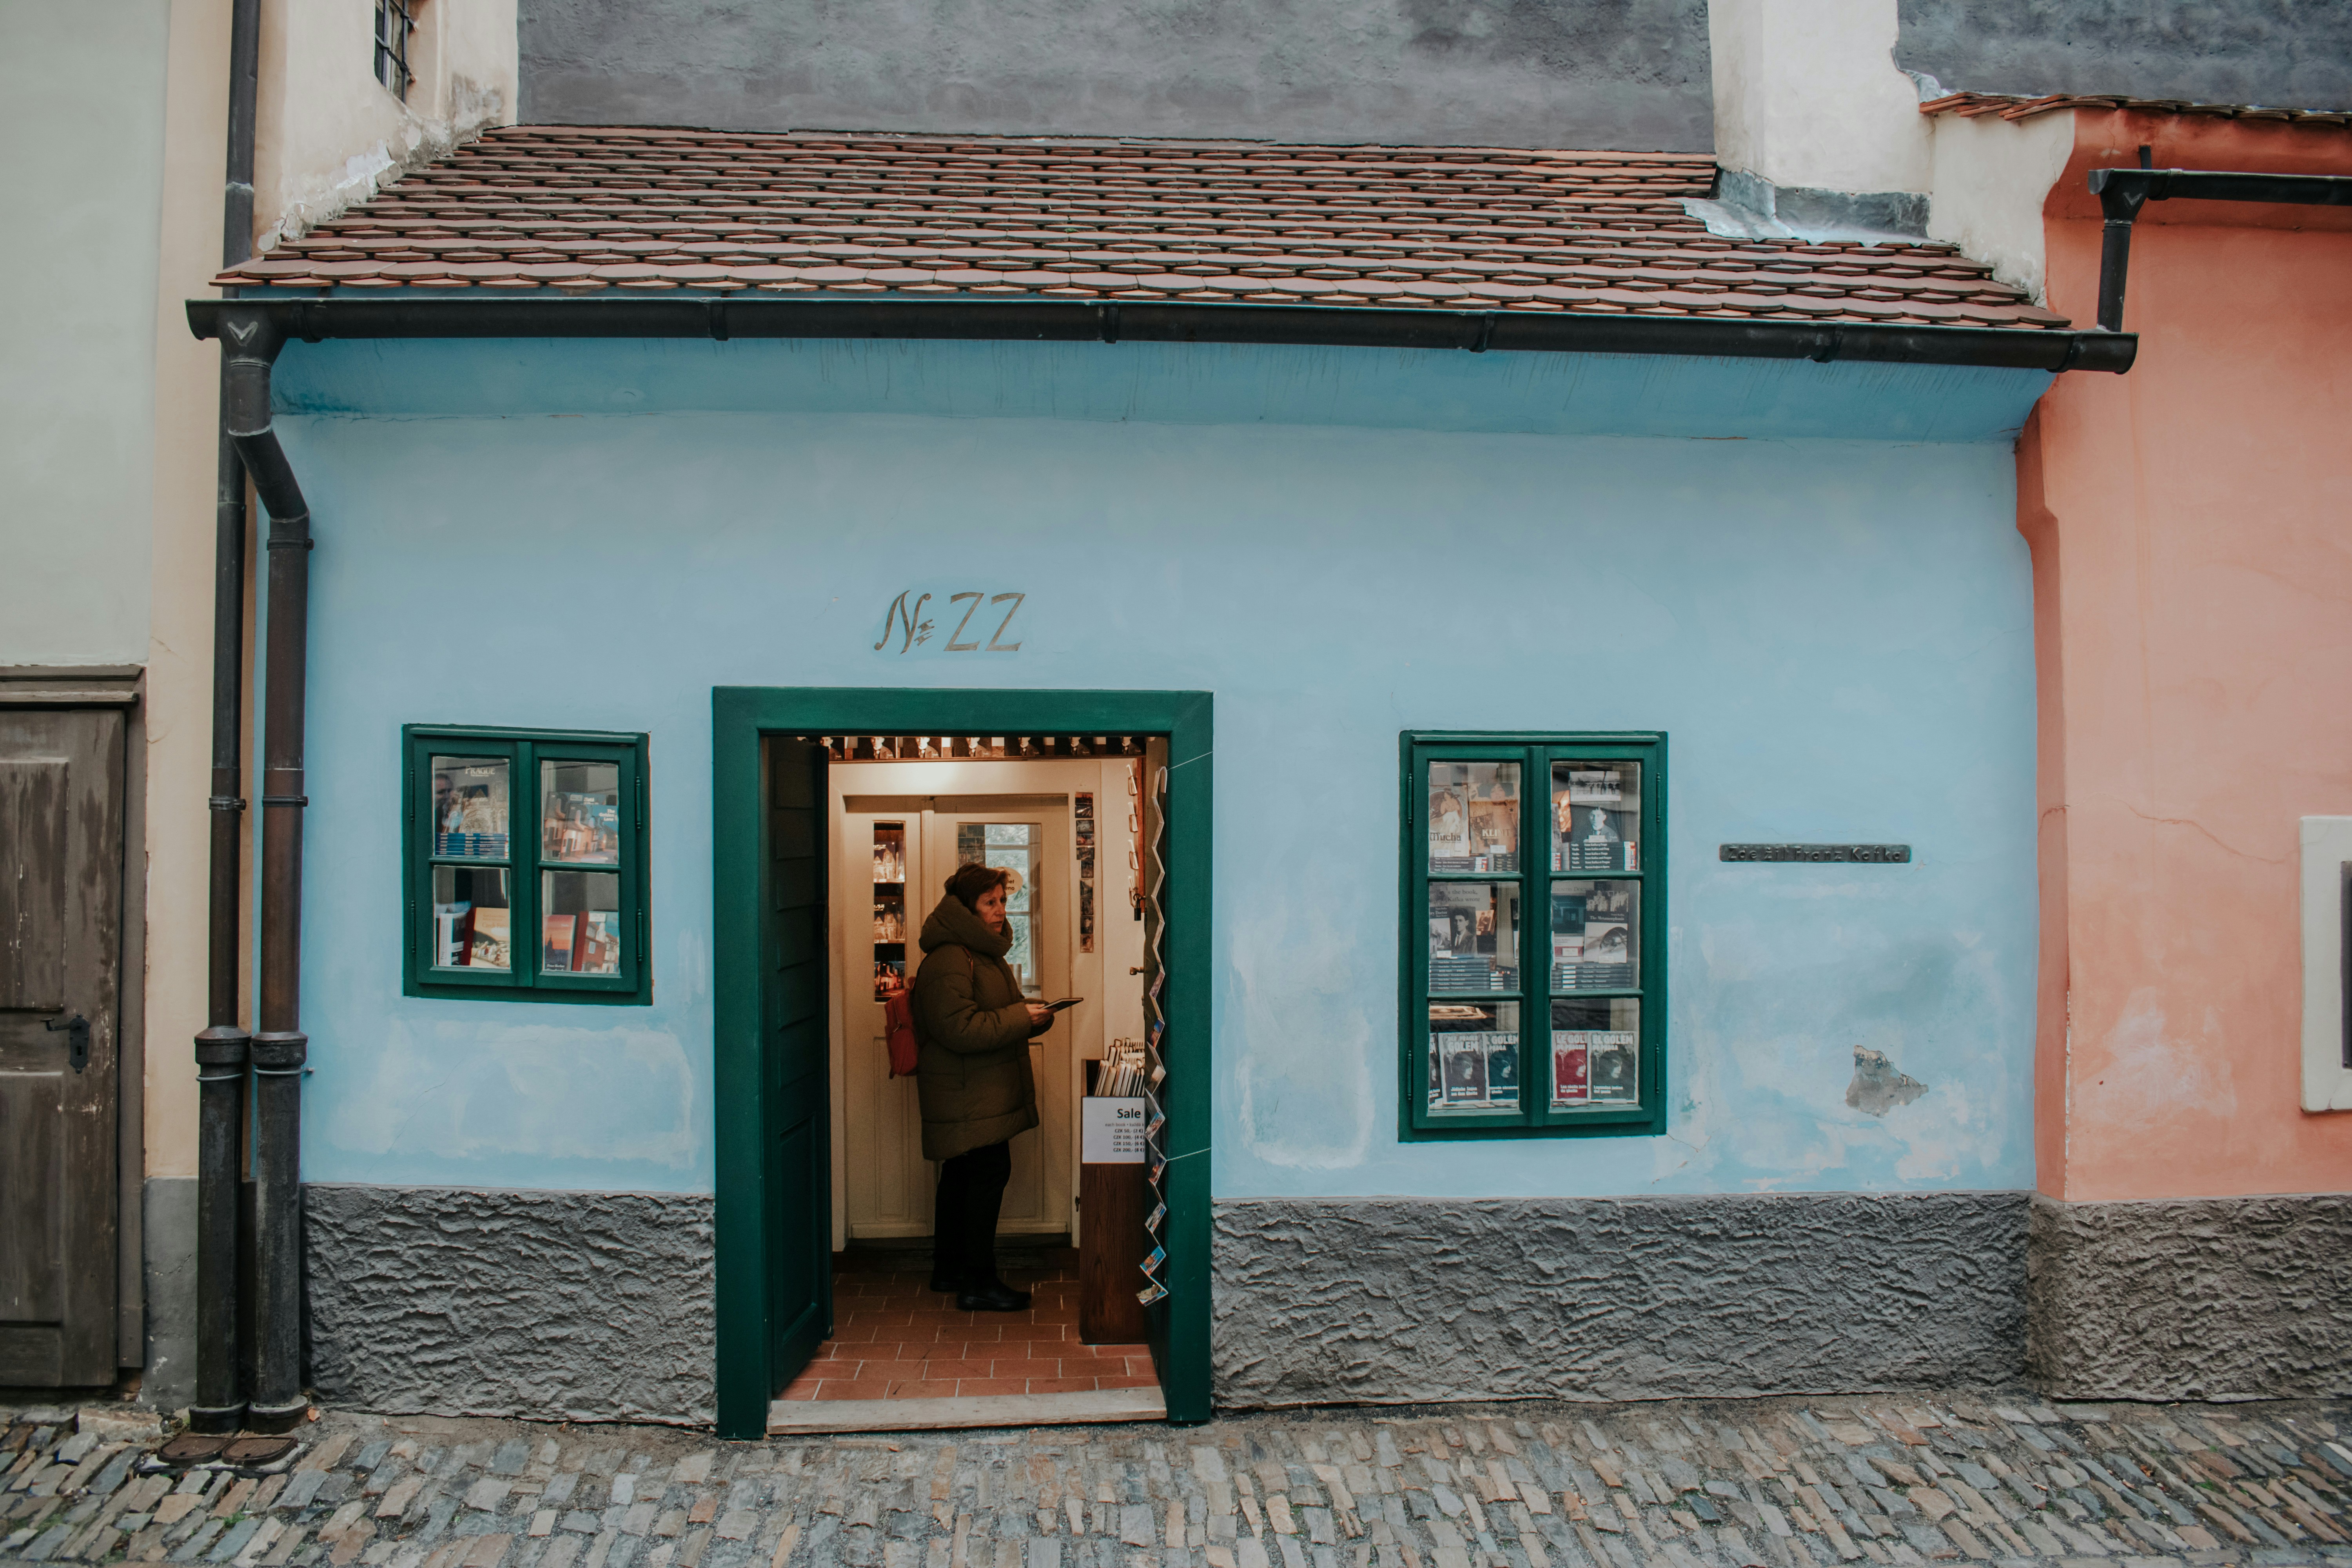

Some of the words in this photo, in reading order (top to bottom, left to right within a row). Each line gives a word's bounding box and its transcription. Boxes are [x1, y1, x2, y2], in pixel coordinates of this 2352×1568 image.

[1430, 832, 1461, 841] Mucha
[1728, 846, 1757, 860] Zde
[1764, 846, 1786, 861] žil
[1793, 846, 1842, 860] Franz
[1850, 847, 1901, 861] Kafka
[1592, 1034, 1602, 1044] EL
[1604, 1034, 1633, 1044] GOLEM
[1448, 1041, 1478, 1052] GOLEM
[1117, 1108, 1141, 1118] Sale
